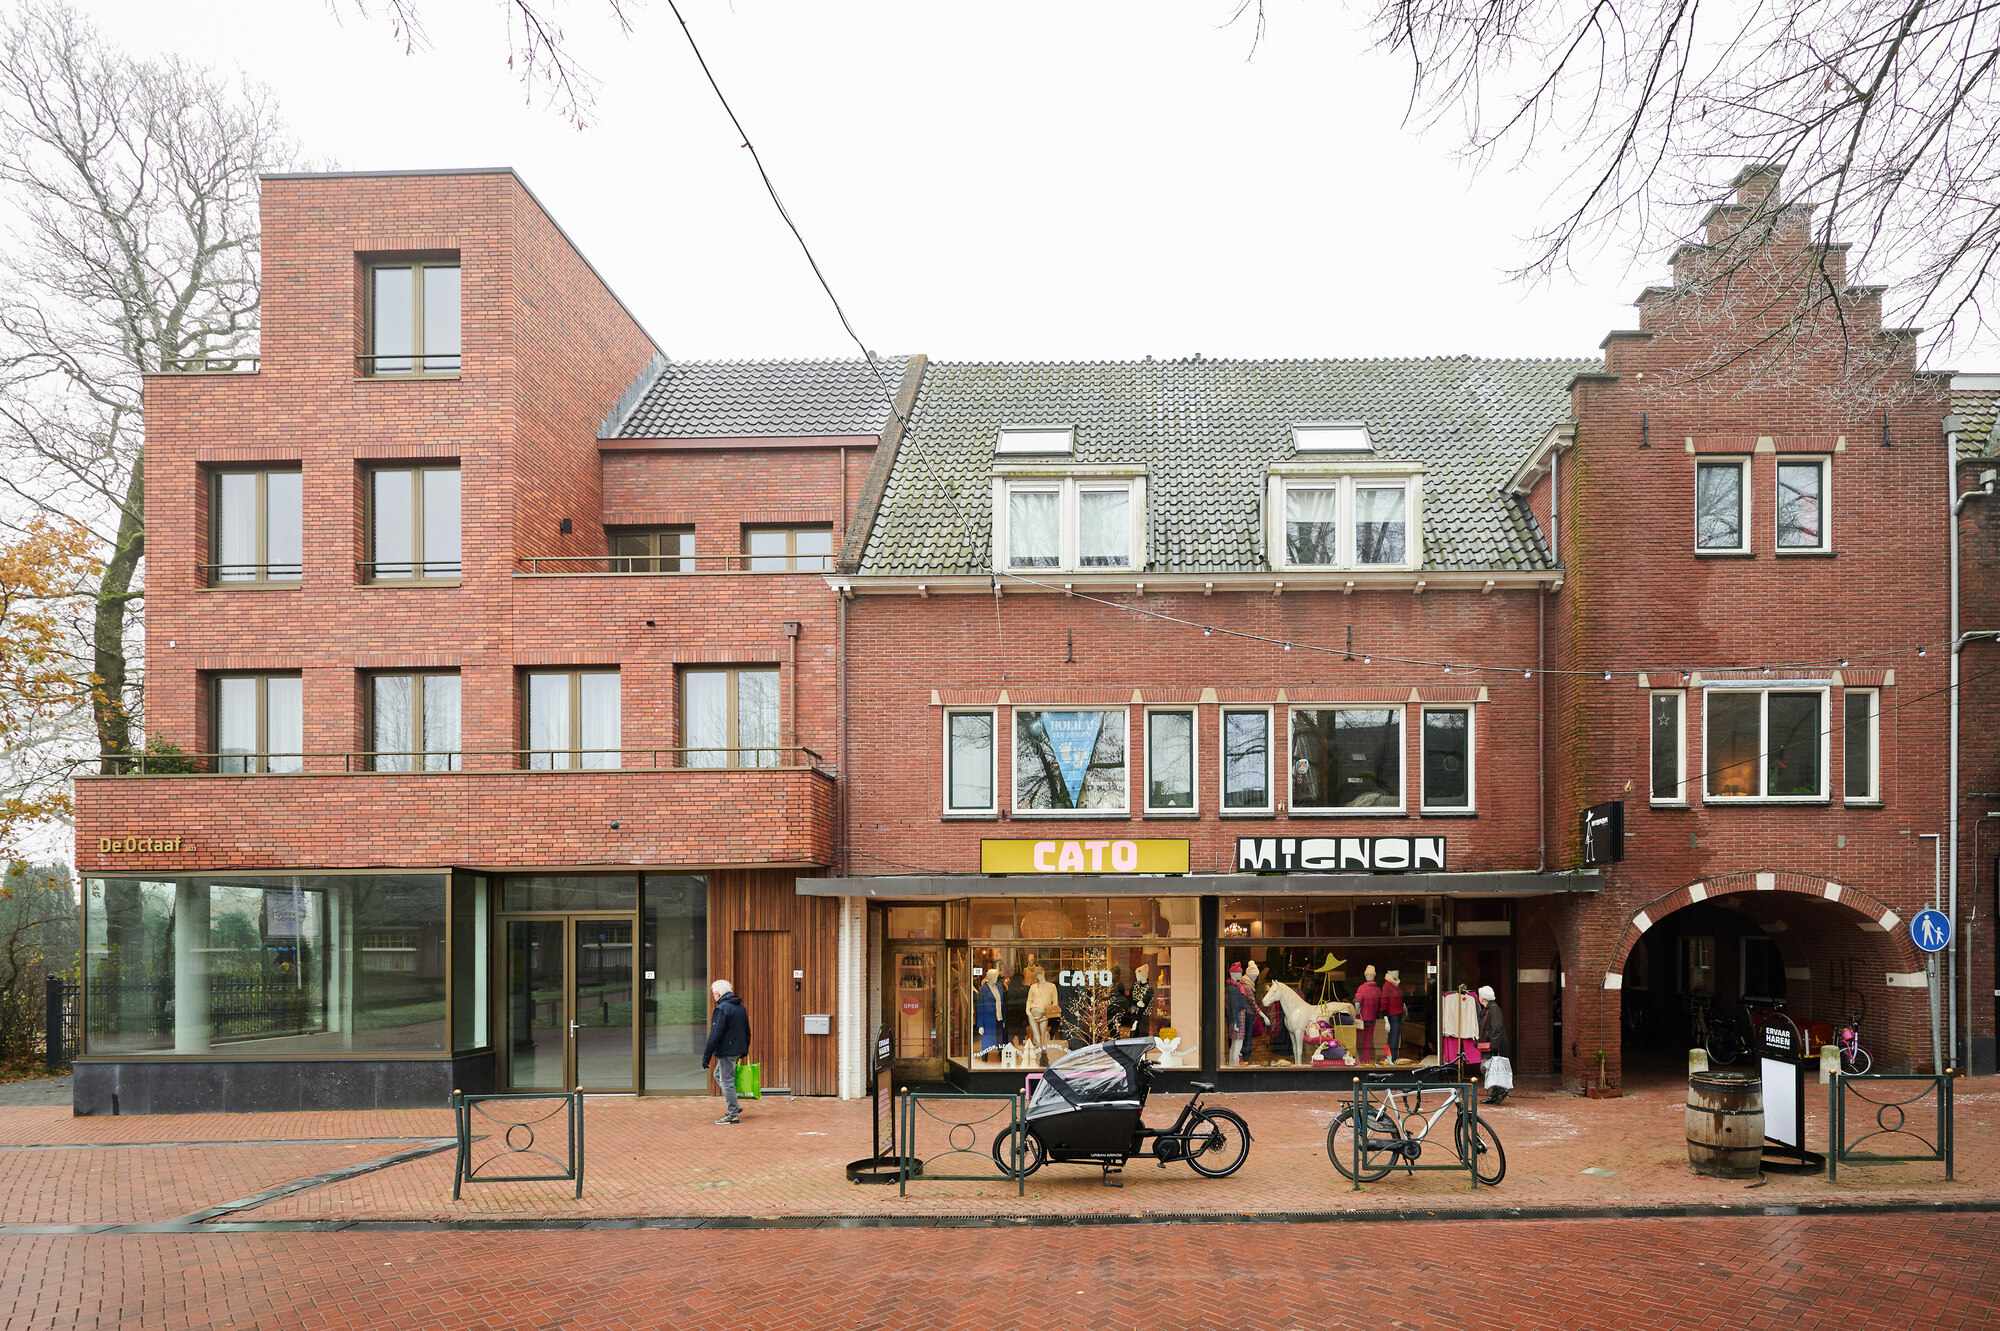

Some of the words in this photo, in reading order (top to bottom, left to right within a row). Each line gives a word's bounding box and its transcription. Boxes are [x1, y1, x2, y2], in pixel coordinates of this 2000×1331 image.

[100, 837, 121, 853] De
[126, 836, 181, 853] Octaaf
[1034, 840, 1137, 872] CATO
[1059, 970, 1112, 987] CATO
[1766, 1027, 1790, 1037] ERVAAR
[1766, 1035, 1790, 1046] HAREN
